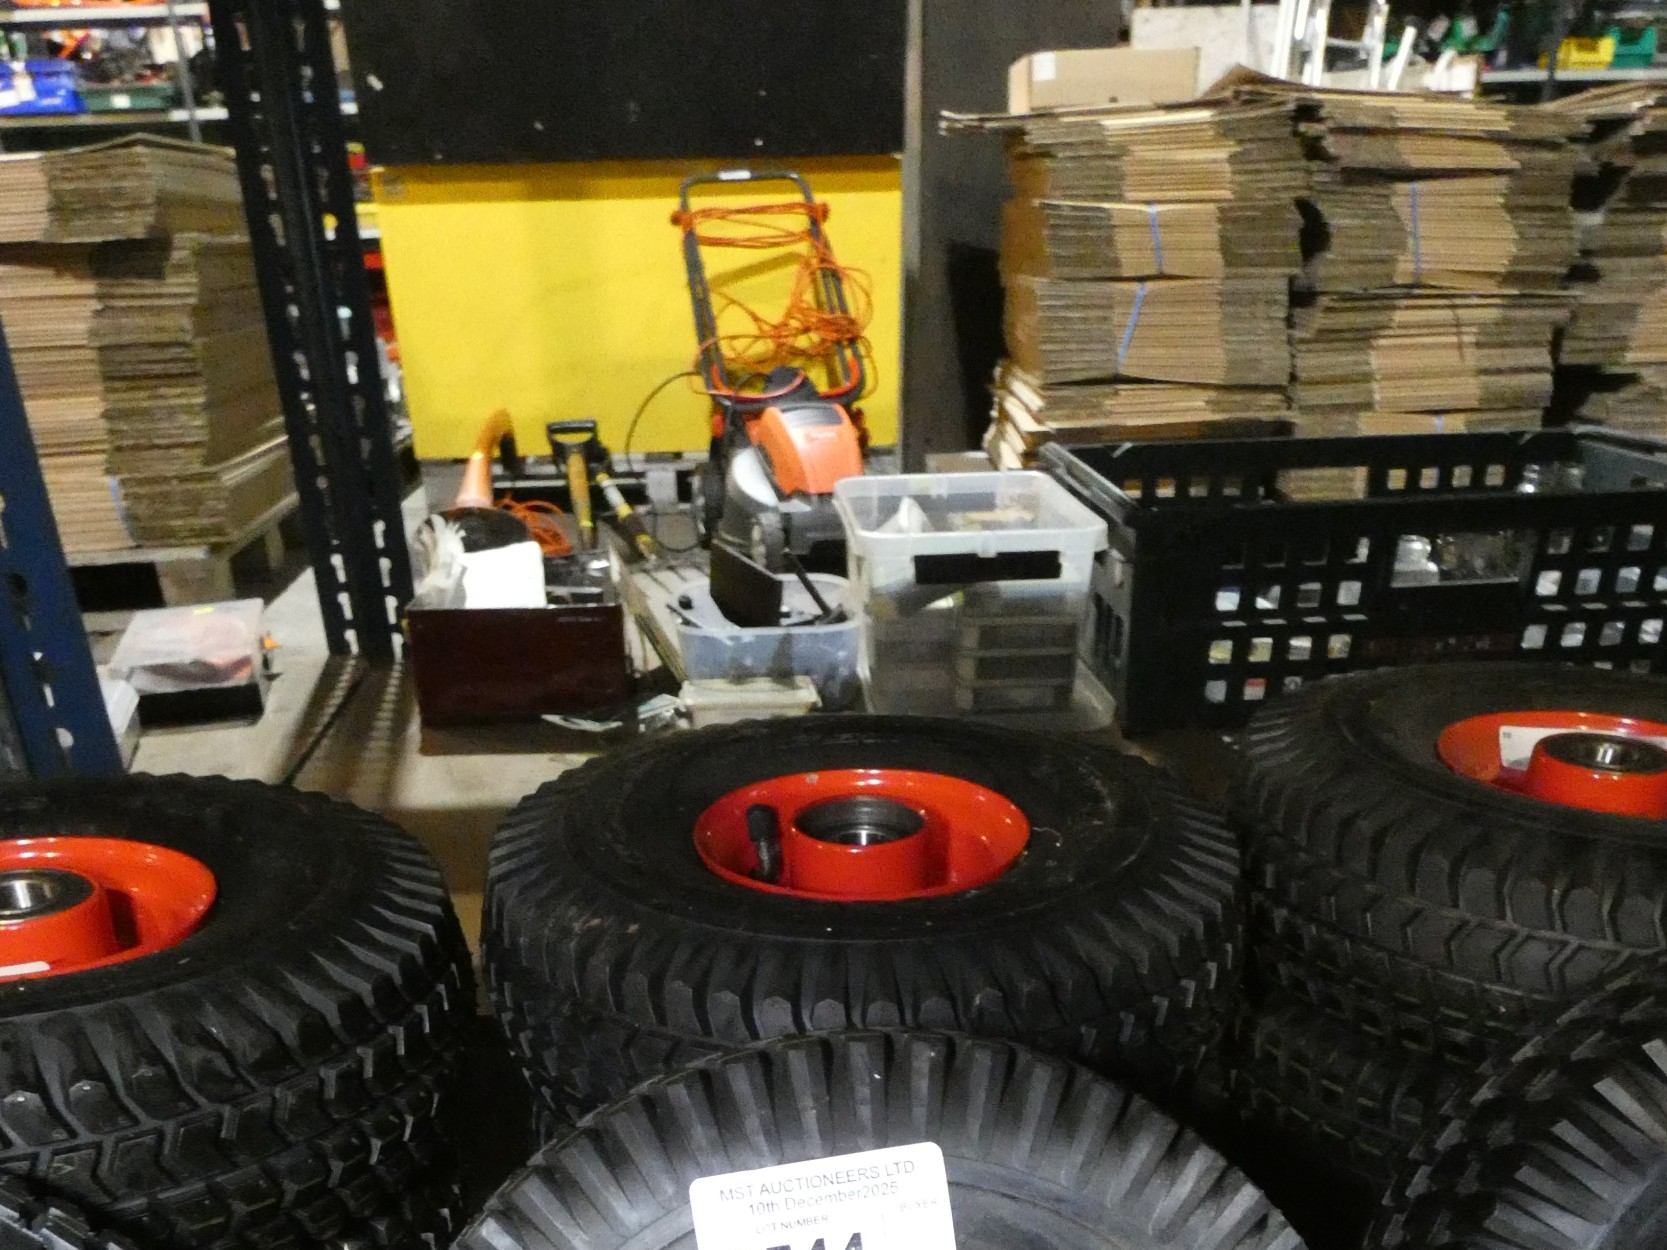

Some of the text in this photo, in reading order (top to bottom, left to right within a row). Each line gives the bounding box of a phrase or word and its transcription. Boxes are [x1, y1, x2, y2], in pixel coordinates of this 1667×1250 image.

[719, 1160, 915, 1202] MST AUCTIONEERS LTD
[748, 1201, 779, 1216] 10th
[780, 1215, 829, 1230] NUMBER
